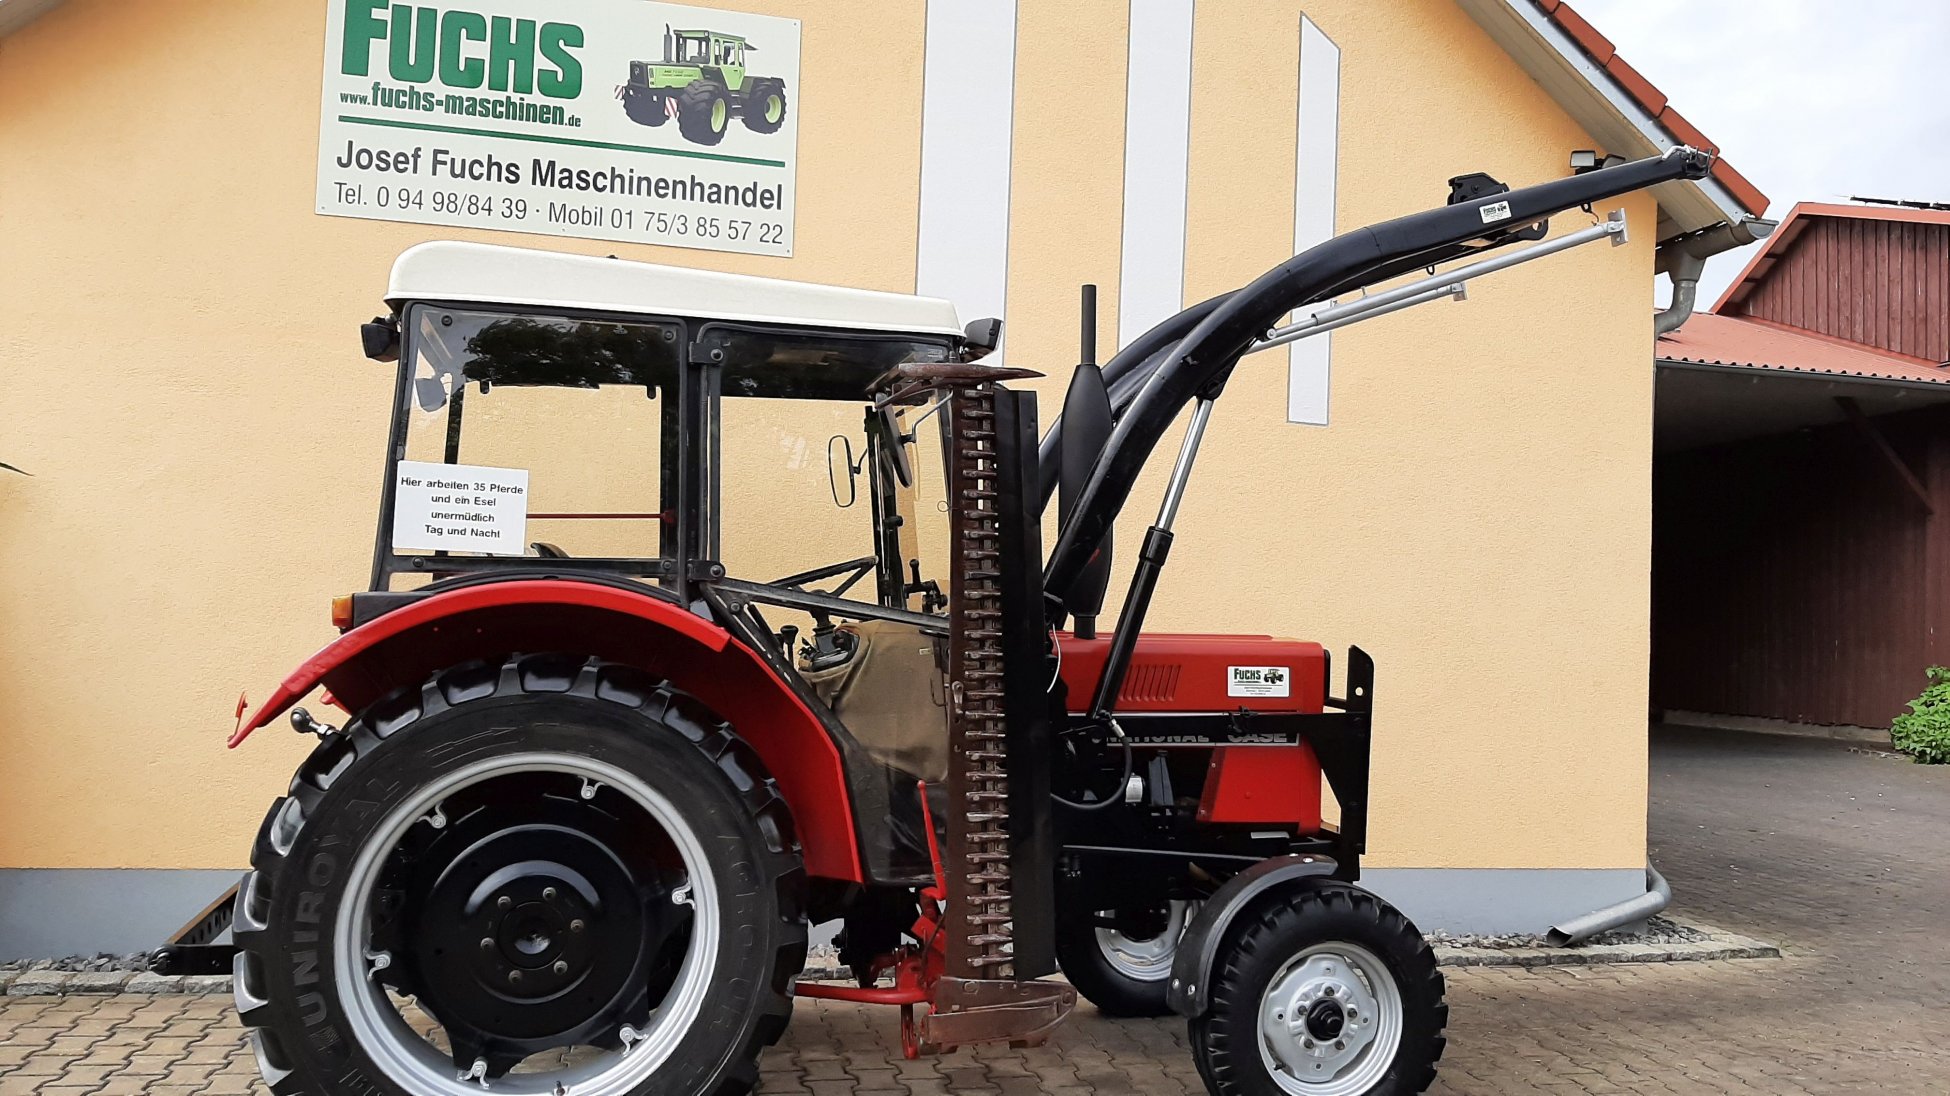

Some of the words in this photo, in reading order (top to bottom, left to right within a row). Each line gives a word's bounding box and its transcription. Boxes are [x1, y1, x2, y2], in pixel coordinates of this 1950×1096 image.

[341, 0, 584, 99] FUCHS
[340, 82, 582, 127] www.fuchs-maschinen.de
[336, 140, 422, 174] Josef
[431, 148, 521, 184] Fuchs
[531, 158, 783, 210] Maschinenhandel
[334, 181, 367, 206] Tel.
[377, 186, 390, 208] 0
[397, 188, 424, 210] 94
[432, 191, 494, 216] 98/84
[501, 197, 527, 219] 39
[548, 201, 603, 227] Mobil
[611, 207, 633, 230] 01
[643, 211, 689, 236] 75/3
[696, 216, 720, 238] 85
[727, 220, 752, 241] 57
[759, 223, 783, 244] 22
[400, 476, 422, 487] Hier
[473, 482, 486, 491] 35
[431, 494, 451, 503] und
[454, 495, 470, 505] ein
[474, 496, 496, 507] Esel
[424, 524, 443, 537] Tag
[447, 527, 467, 536] und
[431, 511, 495, 523] unermüdlich
[1233, 667, 1262, 681] FUCHS
[291, 776, 402, 1028] UNIROYAL
